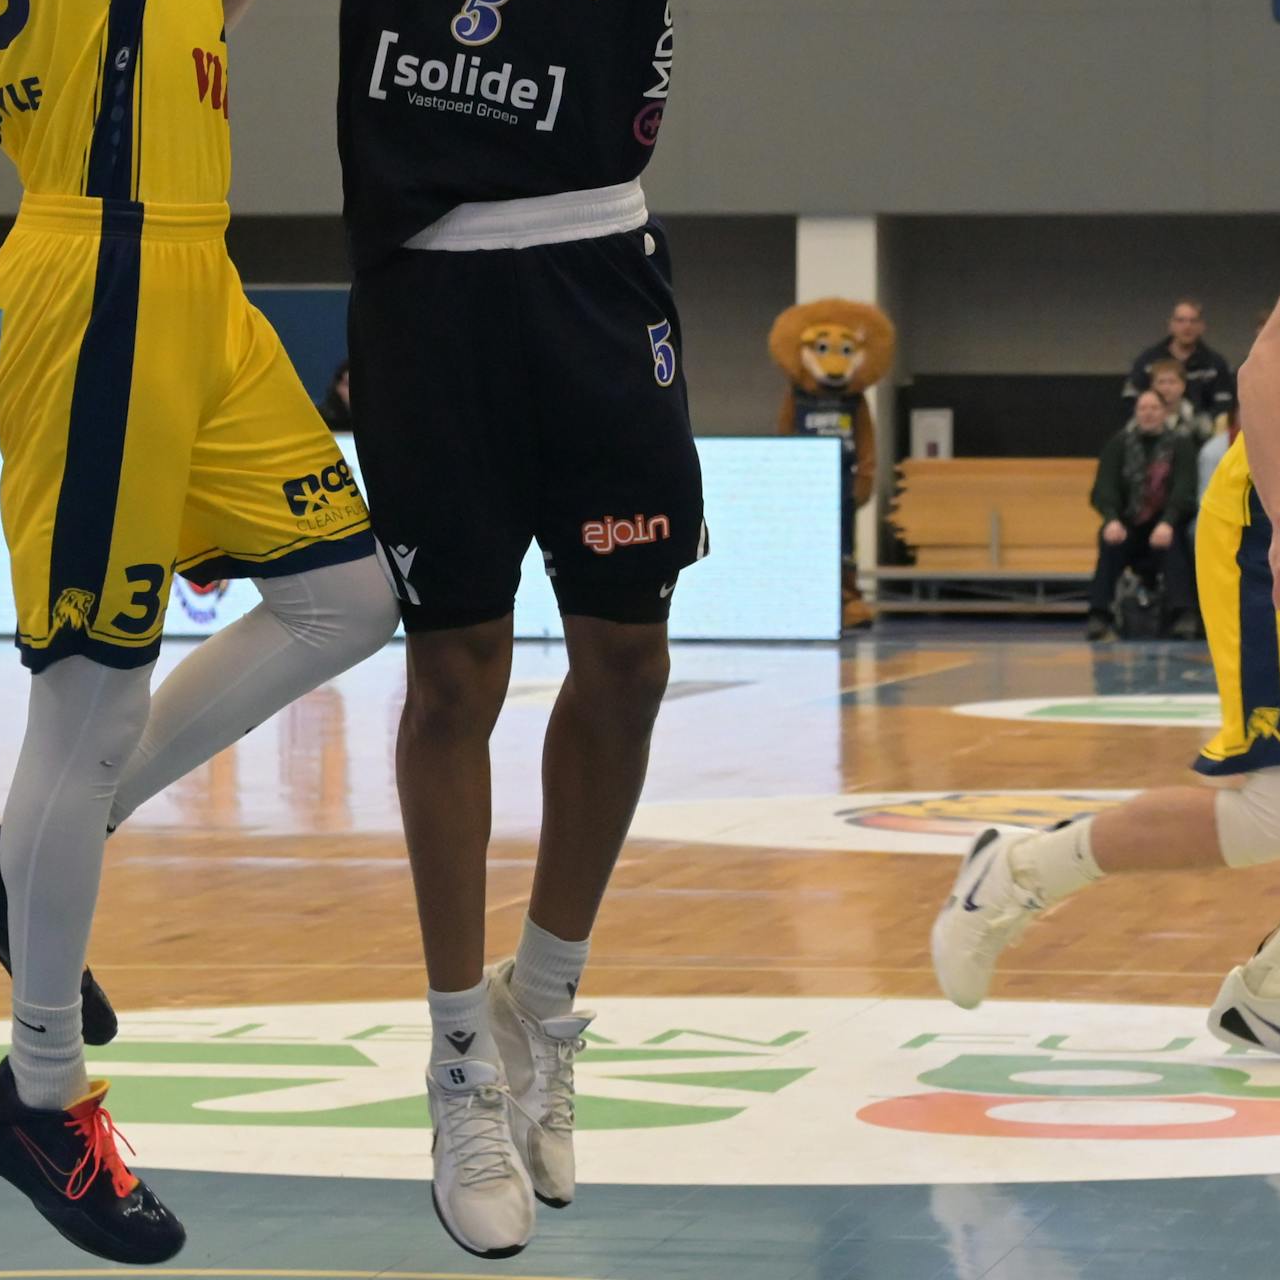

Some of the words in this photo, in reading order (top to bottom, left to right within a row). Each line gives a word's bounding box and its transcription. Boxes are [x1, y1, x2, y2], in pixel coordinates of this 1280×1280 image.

[407, 91, 473, 115] Vastgoed
[477, 103, 519, 125] Groep
[646, 318, 676, 388] 5
[111, 563, 177, 634] 3
[116, 1021, 809, 1048] CLEN
